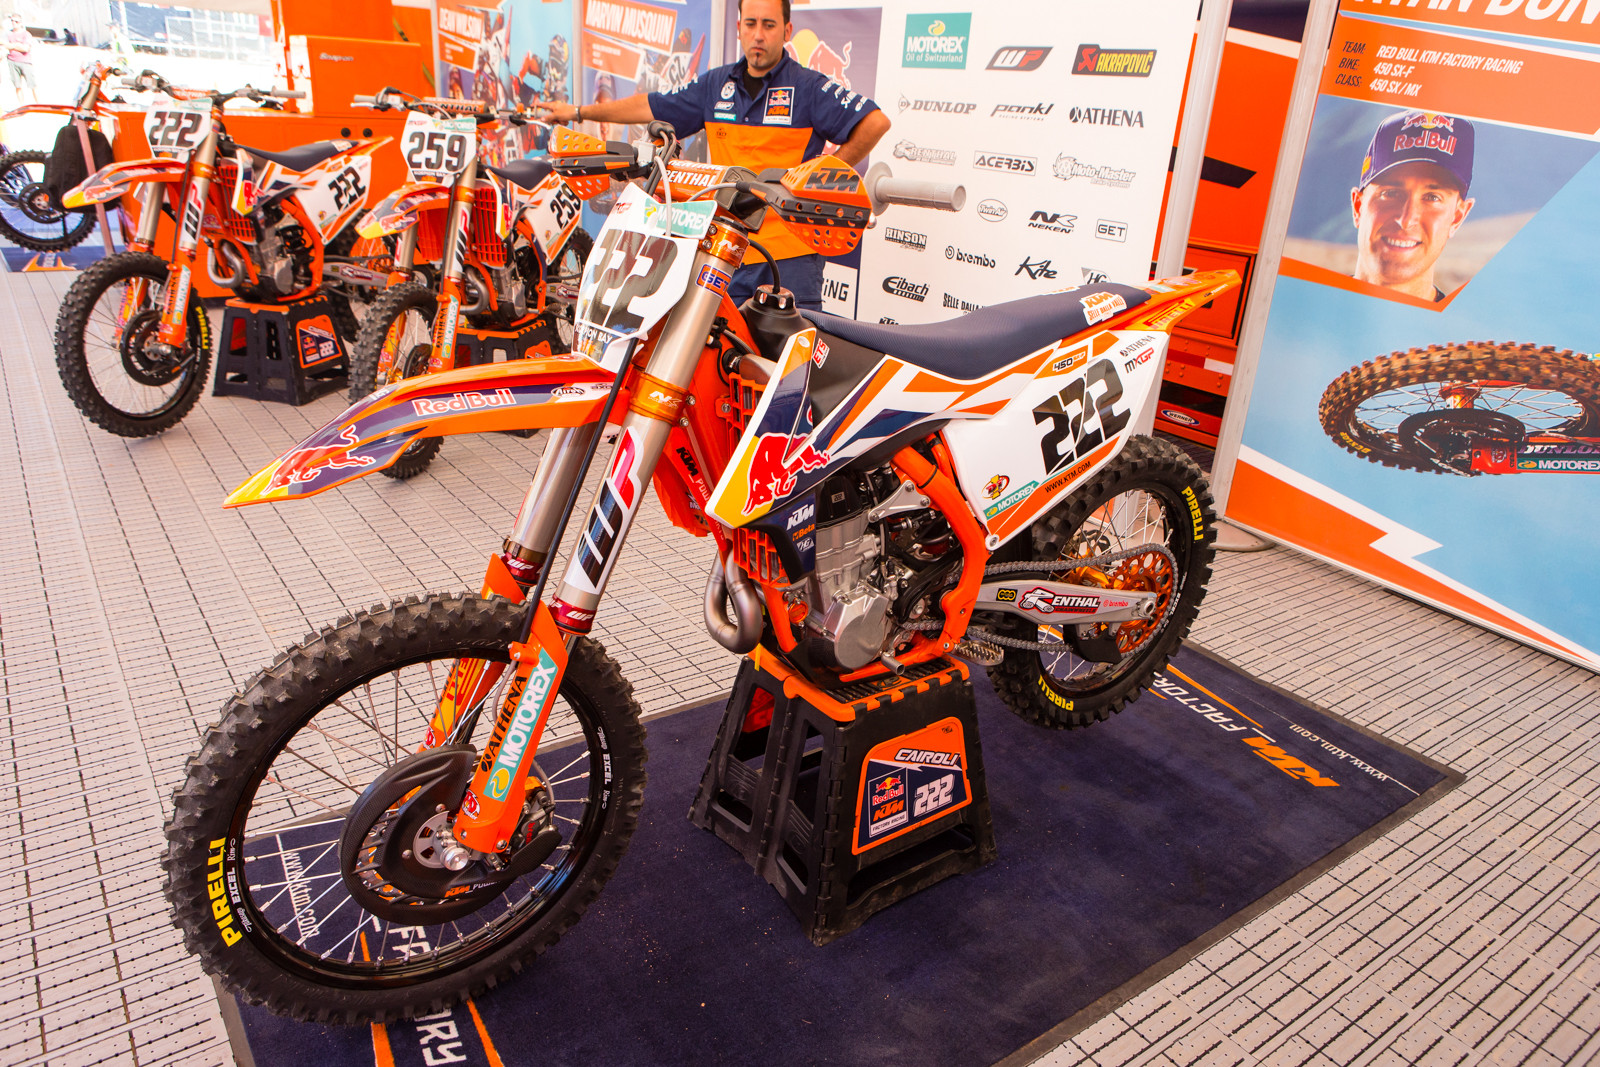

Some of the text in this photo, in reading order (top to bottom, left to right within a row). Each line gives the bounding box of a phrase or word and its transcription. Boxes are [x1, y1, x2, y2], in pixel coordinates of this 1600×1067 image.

[586, 0, 673, 46] MARVIN MUSQUIN
[906, 36, 966, 54] MOTOREX
[1342, 41, 1366, 54] TEAM:
[905, 53, 963, 63] Oil of Switzerland
[1338, 57, 1360, 70] BIKE:
[1373, 62, 1415, 78] 450 SX-F
[1376, 45, 1524, 74] RED BULL KTM FACTORY RACING
[1335, 73, 1362, 87] CLASS:
[1369, 78, 1389, 92] 450
[1386, 80, 1402, 94] SX
[1403, 82, 1422, 97] MX
[911, 99, 977, 115] DUNLOP
[1081, 107, 1144, 129] ATHENA
[149, 111, 203, 147] 222
[407, 132, 467, 172] 259
[1393, 131, 1456, 155] Red Bull
[328, 166, 366, 211] 222
[804, 167, 860, 192] KTM
[550, 182, 581, 228] 259
[885, 228, 927, 247] HINSON
[1027, 222, 1073, 234] NEKEN
[1097, 224, 1125, 238] GET
[956, 249, 996, 268] brembo
[1015, 256, 1057, 280] Kite
[578, 229, 678, 334] 222
[701, 272, 729, 292] GET
[882, 276, 929, 302] Eibach
[943, 293, 959, 309] SELLE
[1084, 292, 1113, 308] KTM
[1088, 298, 1125, 321] SELLE DALLA VALLE
[1128, 335, 1156, 354] ATHENA
[1053, 357, 1073, 371] 450
[1124, 347, 1155, 374] MXGP
[413, 389, 516, 416] Red Bull
[1032, 359, 1132, 474] 222
[1168, 410, 1193, 423] WERNER
[676, 446, 699, 477] KTM
[1044, 460, 1092, 493] WWW.KTM.COM
[997, 482, 1037, 511] MOTOREX
[786, 503, 815, 530] KTM
[1181, 486, 1204, 541] PIRELLI
[566, 610, 594, 621] WP
[1037, 674, 1074, 711] PIRELLI
[489, 676, 528, 757] ATHENA
[498, 659, 556, 768] MOTOREX
[1153, 672, 1340, 787] KTM FACTOR
[894, 748, 958, 766] CAIROLI
[1289, 723, 1388, 782] www.ktm.com
[602, 753, 612, 785] EXCEL
[872, 783, 904, 806] Red Bull
[913, 773, 955, 817] 222
[872, 799, 905, 822] KTM
[207, 837, 242, 947] PIRELLI
[227, 867, 241, 904] EXCEL
[444, 885, 470, 898] KTM
